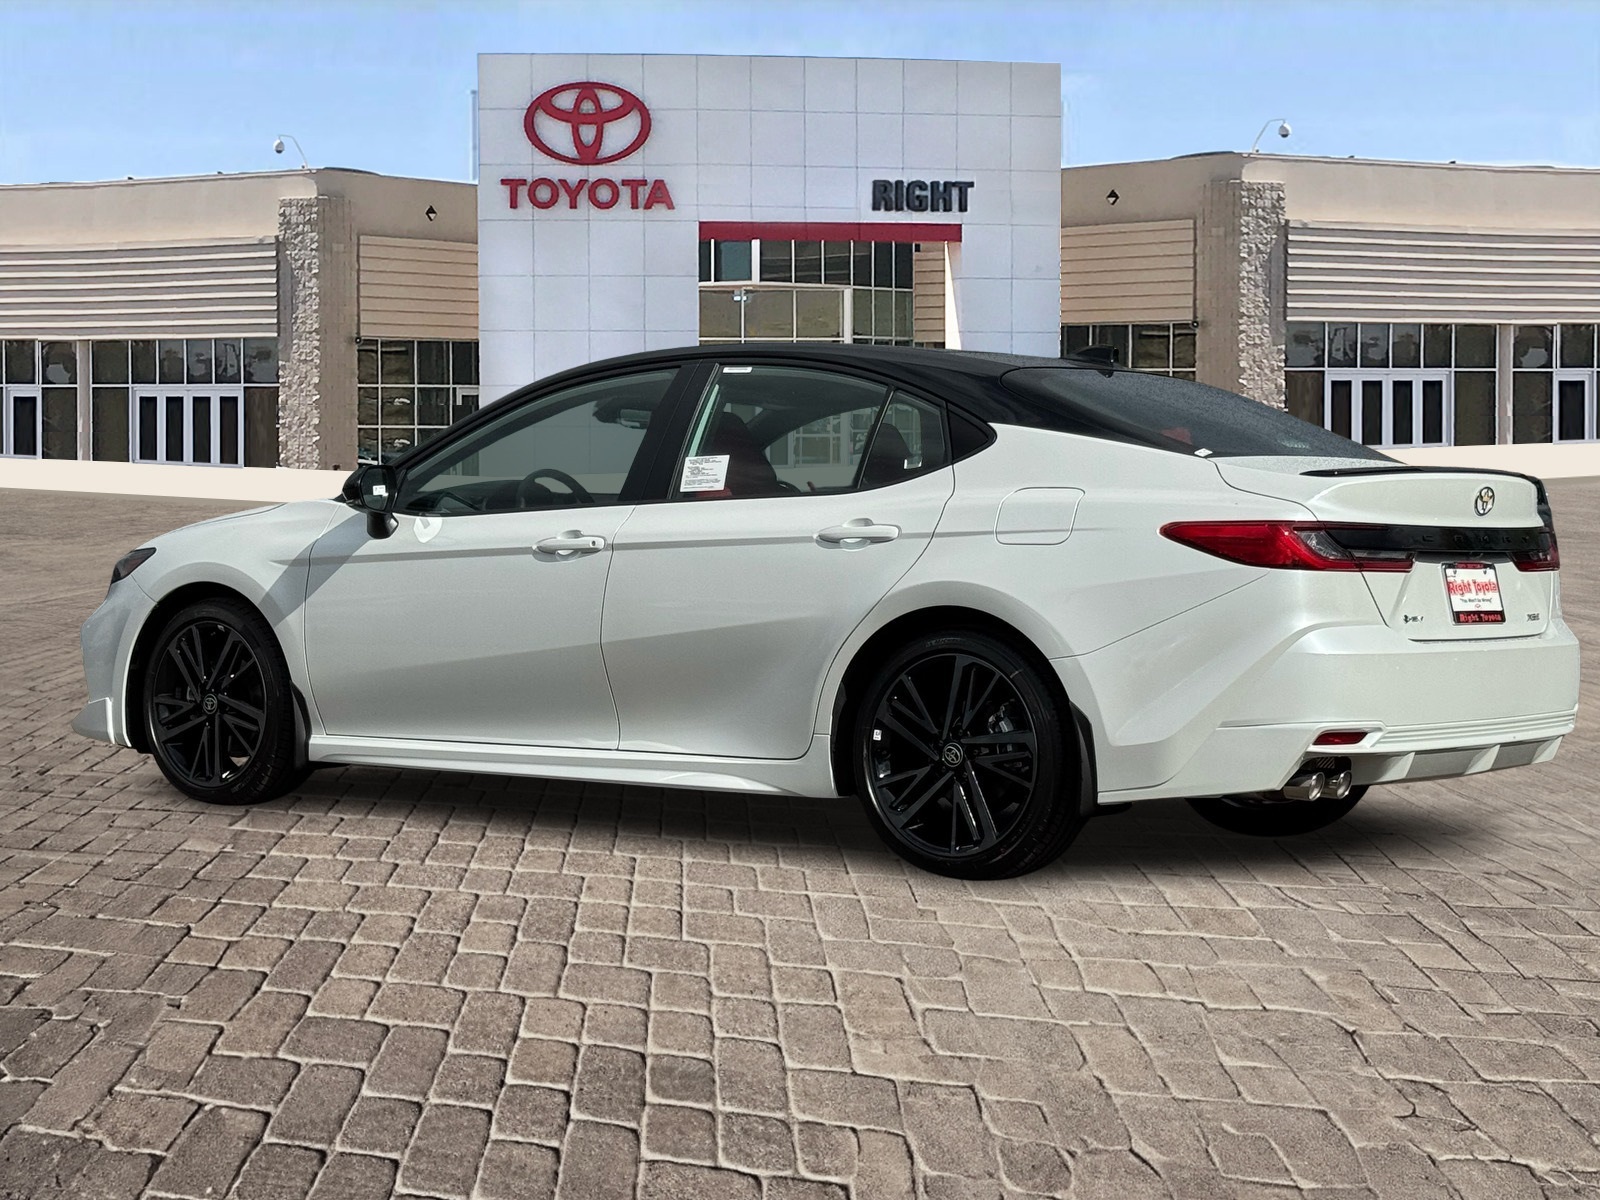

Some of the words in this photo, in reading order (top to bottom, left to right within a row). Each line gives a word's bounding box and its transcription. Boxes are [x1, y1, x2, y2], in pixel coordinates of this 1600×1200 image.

[500, 179, 675, 209] TOYOTA
[871, 179, 975, 212] RIGHT
[1448, 580, 1471, 596] Right
[1472, 579, 1498, 596] Toyota
[1459, 613, 1479, 623] Right
[1480, 613, 1502, 622] Toyota
